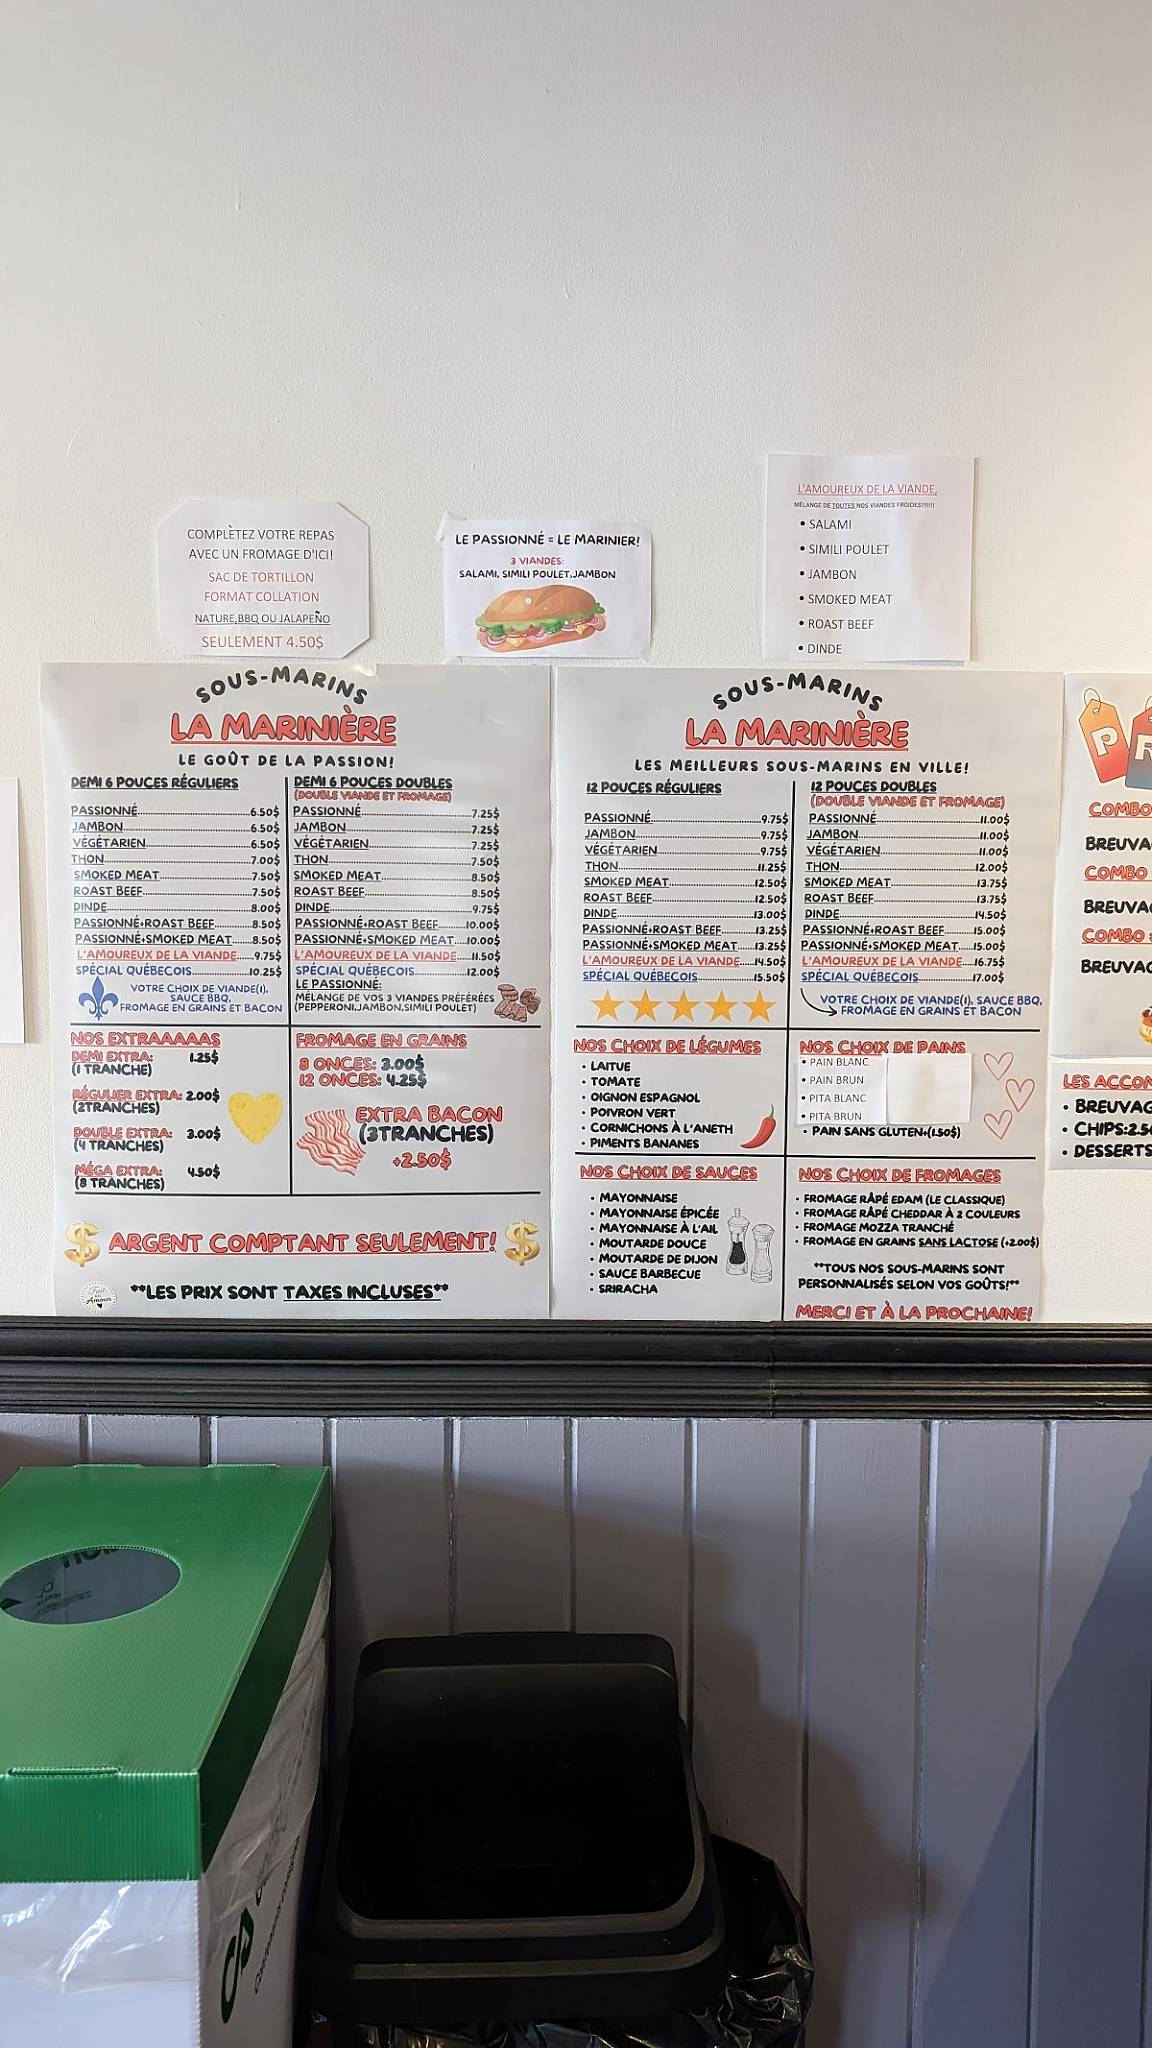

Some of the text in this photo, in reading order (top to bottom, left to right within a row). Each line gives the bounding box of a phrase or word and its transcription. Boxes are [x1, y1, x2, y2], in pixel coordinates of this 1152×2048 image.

[798, 484, 937, 495] L'AMOUREUX DE LA VIANDE,
[809, 520, 852, 530] SALAMI
[187, 525, 334, 541] COMPLÈTEZ VOTRE REPAS
[456, 534, 469, 545] LE
[473, 531, 544, 545] PASSIONNÉ
[558, 534, 570, 545] LE
[574, 535, 639, 547] MARINIER!
[189, 549, 219, 560] AVEC
[223, 549, 238, 560] UN
[242, 549, 299, 560] FROMAGE
[809, 544, 889, 555] SIMILI POULET
[511, 557, 564, 565] 3 VIANDES:
[209, 572, 314, 582] SAC DE TORTILLON
[460, 570, 500, 579] SALAMI,
[503, 570, 529, 579] SIMILI
[808, 569, 857, 580] JAMBON
[204, 592, 319, 602] FORMAT COLLATION
[808, 594, 892, 604] SMOKED MEAT
[262, 614, 275, 624] OU
[279, 610, 330, 623] JALAPEÑO
[809, 619, 874, 629] ROAST BEEF
[202, 636, 323, 649] SEULEMENT 4.50$
[808, 644, 842, 654] DINDE
[196, 666, 368, 704] SOUS-MARINS
[713, 673, 883, 711] SOUS-MARINS
[171, 705, 396, 743] LA MARINIÈRE
[686, 711, 909, 749] LA MARINIÈRE
[179, 750, 395, 767] LE GOÛT DE LA PASSION!
[635, 759, 969, 773] LES MEILLEURS SOUS-MARINS EN VILLE!
[72, 774, 239, 789] DEMI 6 POUCES RÉGULIERS
[294, 777, 452, 789] DEMI 6 POUCES DOUBLES
[587, 778, 721, 794] 12 POUCES RÉGULIERS
[811, 780, 937, 793] 12 POUCES DOUBLES
[294, 790, 451, 802] (DOUBLE VIANDE ET FROMAGE)
[74, 870, 123, 881] SMOKED
[1085, 866, 1148, 879] COMBO
[1082, 928, 1145, 942] COMBO
[296, 1032, 466, 1046] FROMAGE EN GRAINS
[574, 1035, 762, 1054] NOS CHOIX DE LÉGUMES
[800, 1041, 965, 1055] NOS CHOIX DE PAINS
[72, 1050, 219, 1064] DEMI EXTRA: 1.25$
[300, 1055, 424, 1072] 8 ONCES: 3.00$
[810, 1057, 869, 1067] PAIN BLANC
[85, 1063, 152, 1076] TRANCHE)
[591, 1061, 631, 1072] LAITUE
[591, 1076, 640, 1087] TOMATE
[810, 1075, 864, 1085] PAIN BRUN
[1063, 1073, 1090, 1088] LES
[591, 1092, 700, 1104] OIGNON ESPAGNOL
[810, 1093, 866, 1103] PITA BLANC
[72, 1101, 160, 1115] (2TRANCHES)
[356, 1106, 502, 1122] EXTRA BACON
[590, 1108, 675, 1118] POIVRON VERT
[591, 1119, 733, 1134] CORNICHONS À L'ANETH
[358, 1124, 493, 1144] (3TRANCHES)
[392, 1149, 451, 1170] +2.50$
[109, 1232, 496, 1253] ARGENT COMPTANT SEULEMENT!
[858, 1263, 883, 1275] NOS
[887, 1263, 967, 1275] SOUS-MARINS
[971, 1263, 1004, 1275] SONT
[181, 1284, 222, 1301] PRIX
[228, 1284, 277, 1301] SONT
[283, 1284, 343, 1301] TAXES
[796, 1301, 1033, 1321] MERCI ET À LA PROCHAINE!
